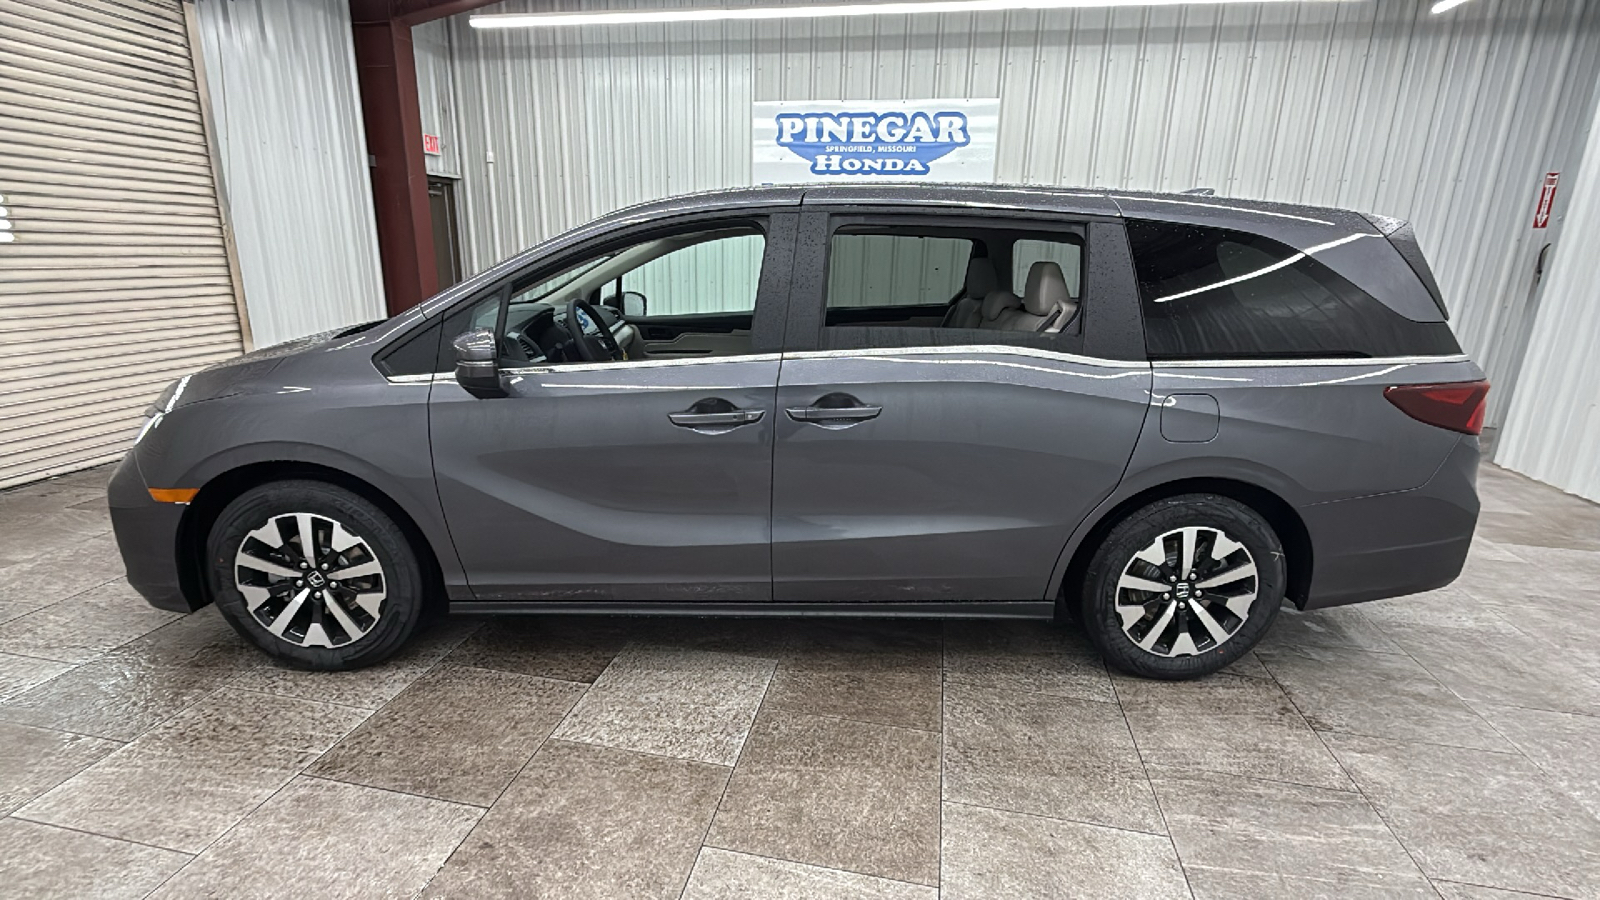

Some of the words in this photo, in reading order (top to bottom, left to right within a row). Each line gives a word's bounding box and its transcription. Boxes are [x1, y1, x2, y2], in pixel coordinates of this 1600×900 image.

[779, 116, 967, 143] PINEGAR
[425, 134, 439, 153] EXIT
[825, 145, 876, 154] SPRINGFIELD,
[877, 145, 917, 153] MISSOURI
[814, 155, 926, 171] HONDA
